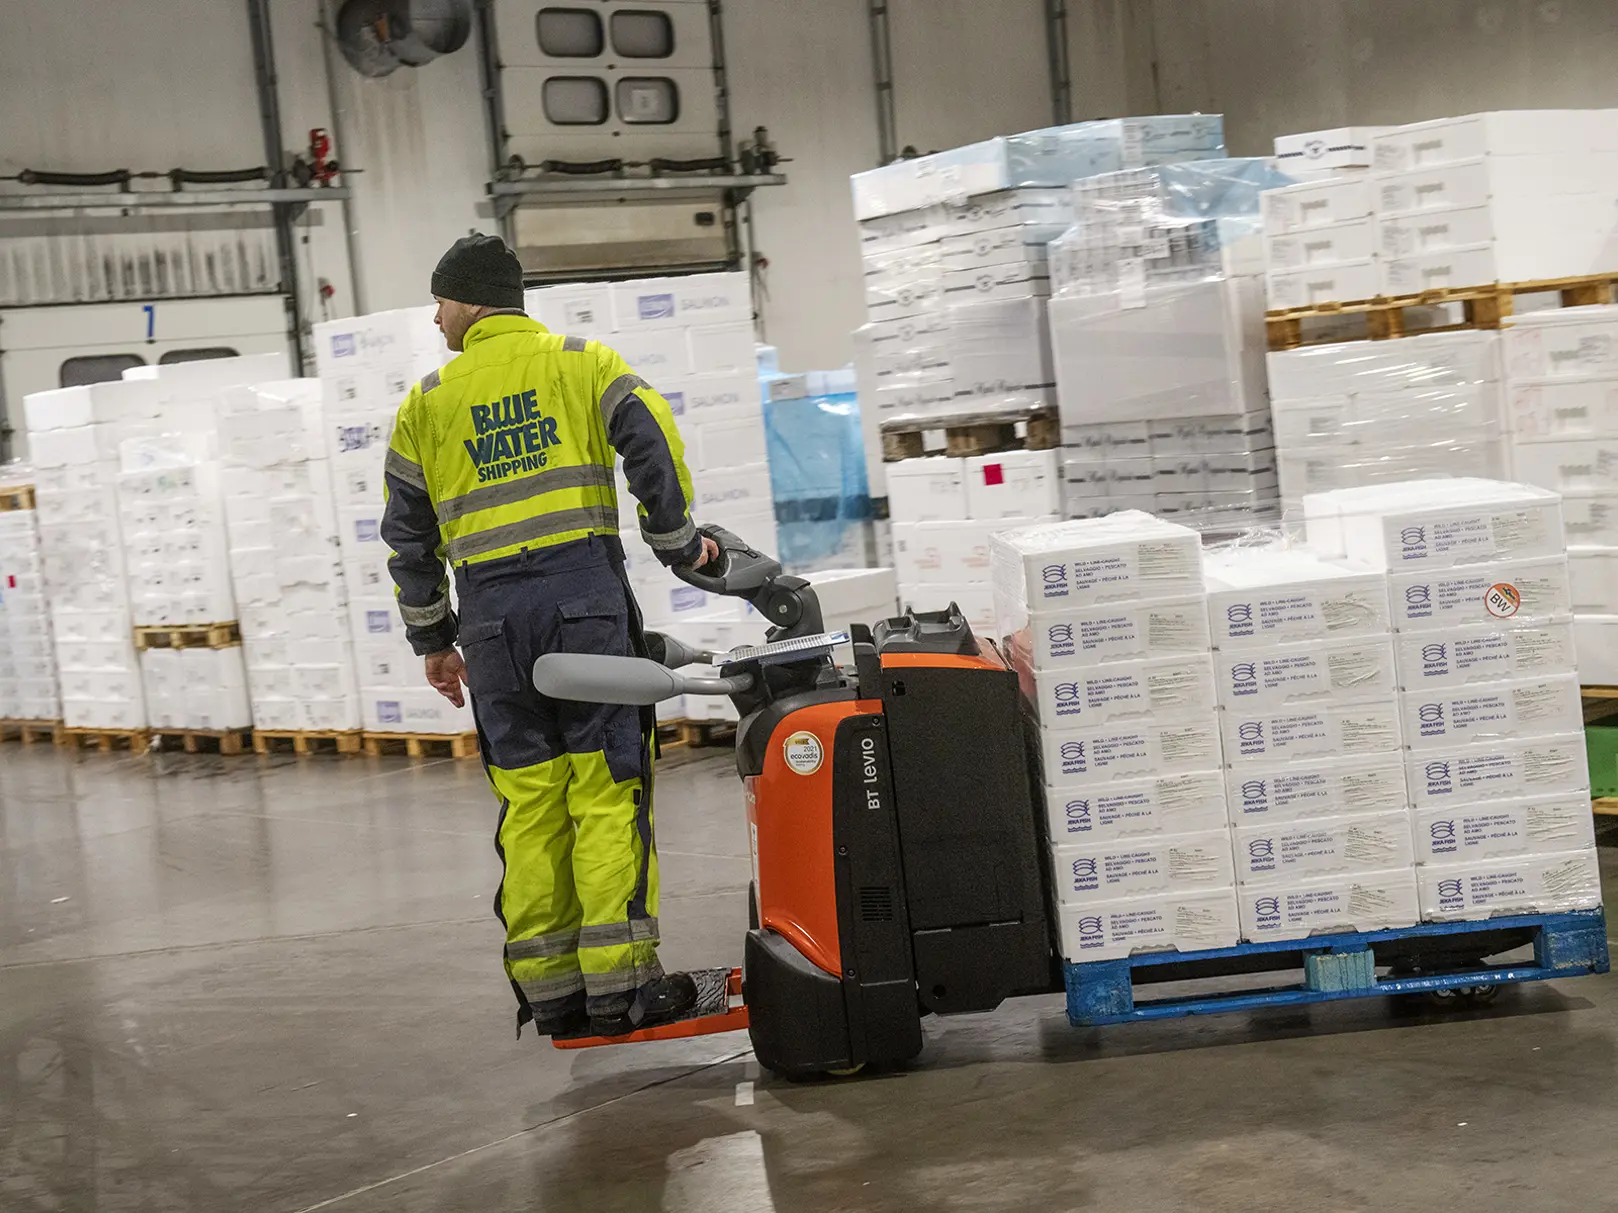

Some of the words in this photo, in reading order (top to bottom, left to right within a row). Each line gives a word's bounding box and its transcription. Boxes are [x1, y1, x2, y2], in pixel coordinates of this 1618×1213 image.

[143, 305, 154, 338] 7
[470, 388, 541, 436] BLUE
[463, 416, 562, 469] WATER
[477, 452, 548, 483] SHIPPING
[1489, 593, 1511, 612] BW
[866, 789, 881, 809] BT
